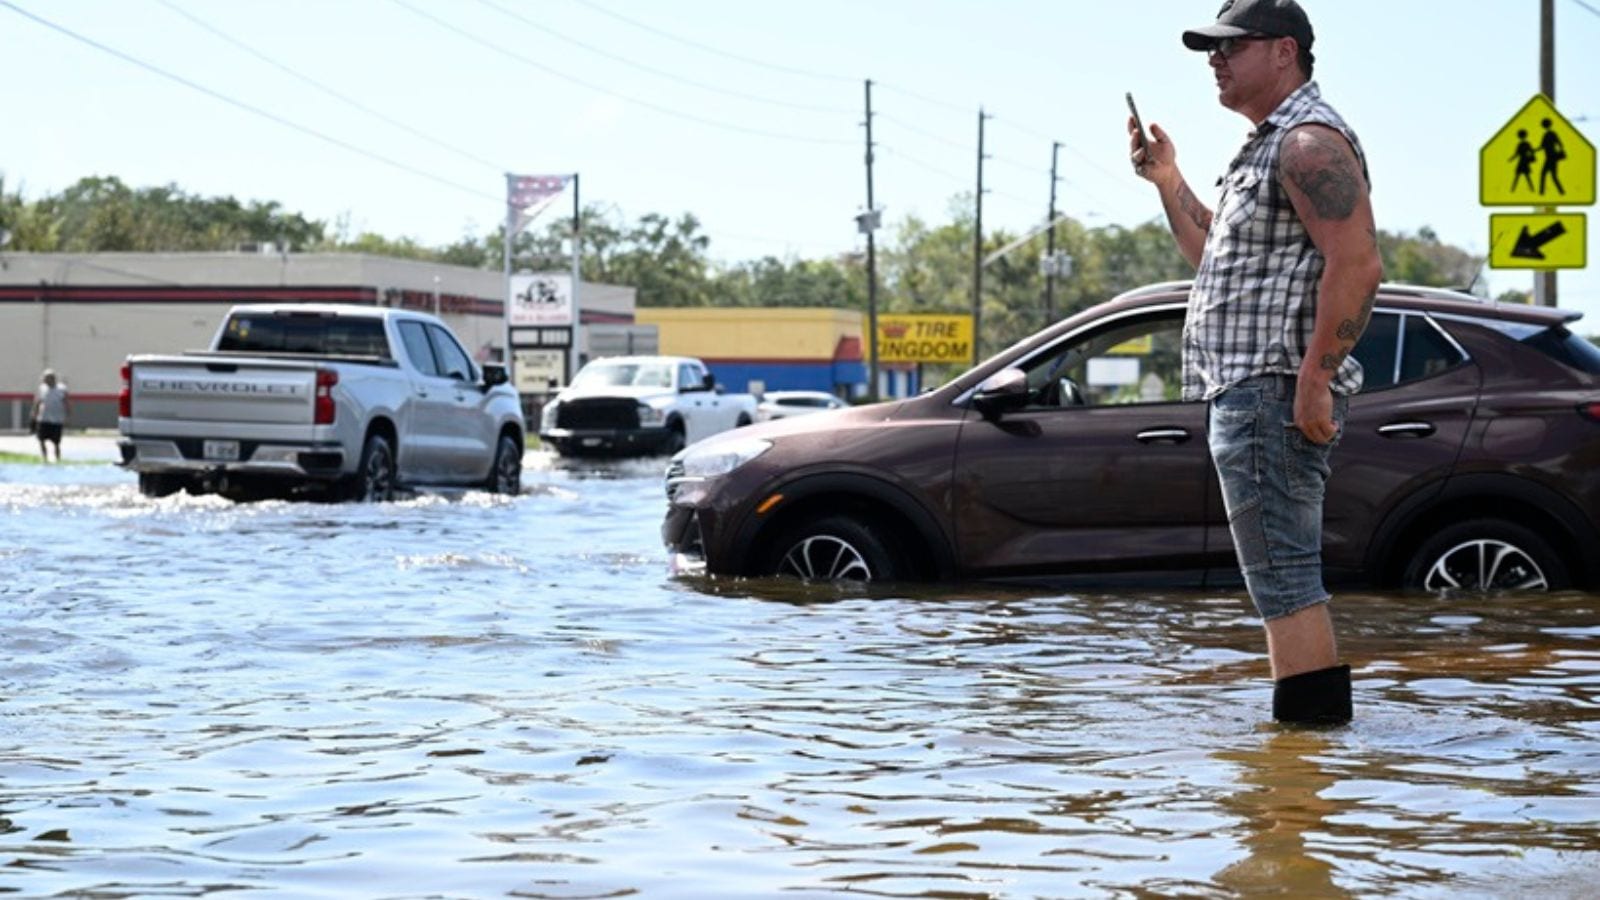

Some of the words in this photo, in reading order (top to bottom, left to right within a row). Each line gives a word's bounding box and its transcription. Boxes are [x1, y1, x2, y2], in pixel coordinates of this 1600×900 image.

[916, 321, 960, 338] TIRE
[877, 341, 968, 358] INGDOM
[142, 380, 300, 395] CHEVROLET
